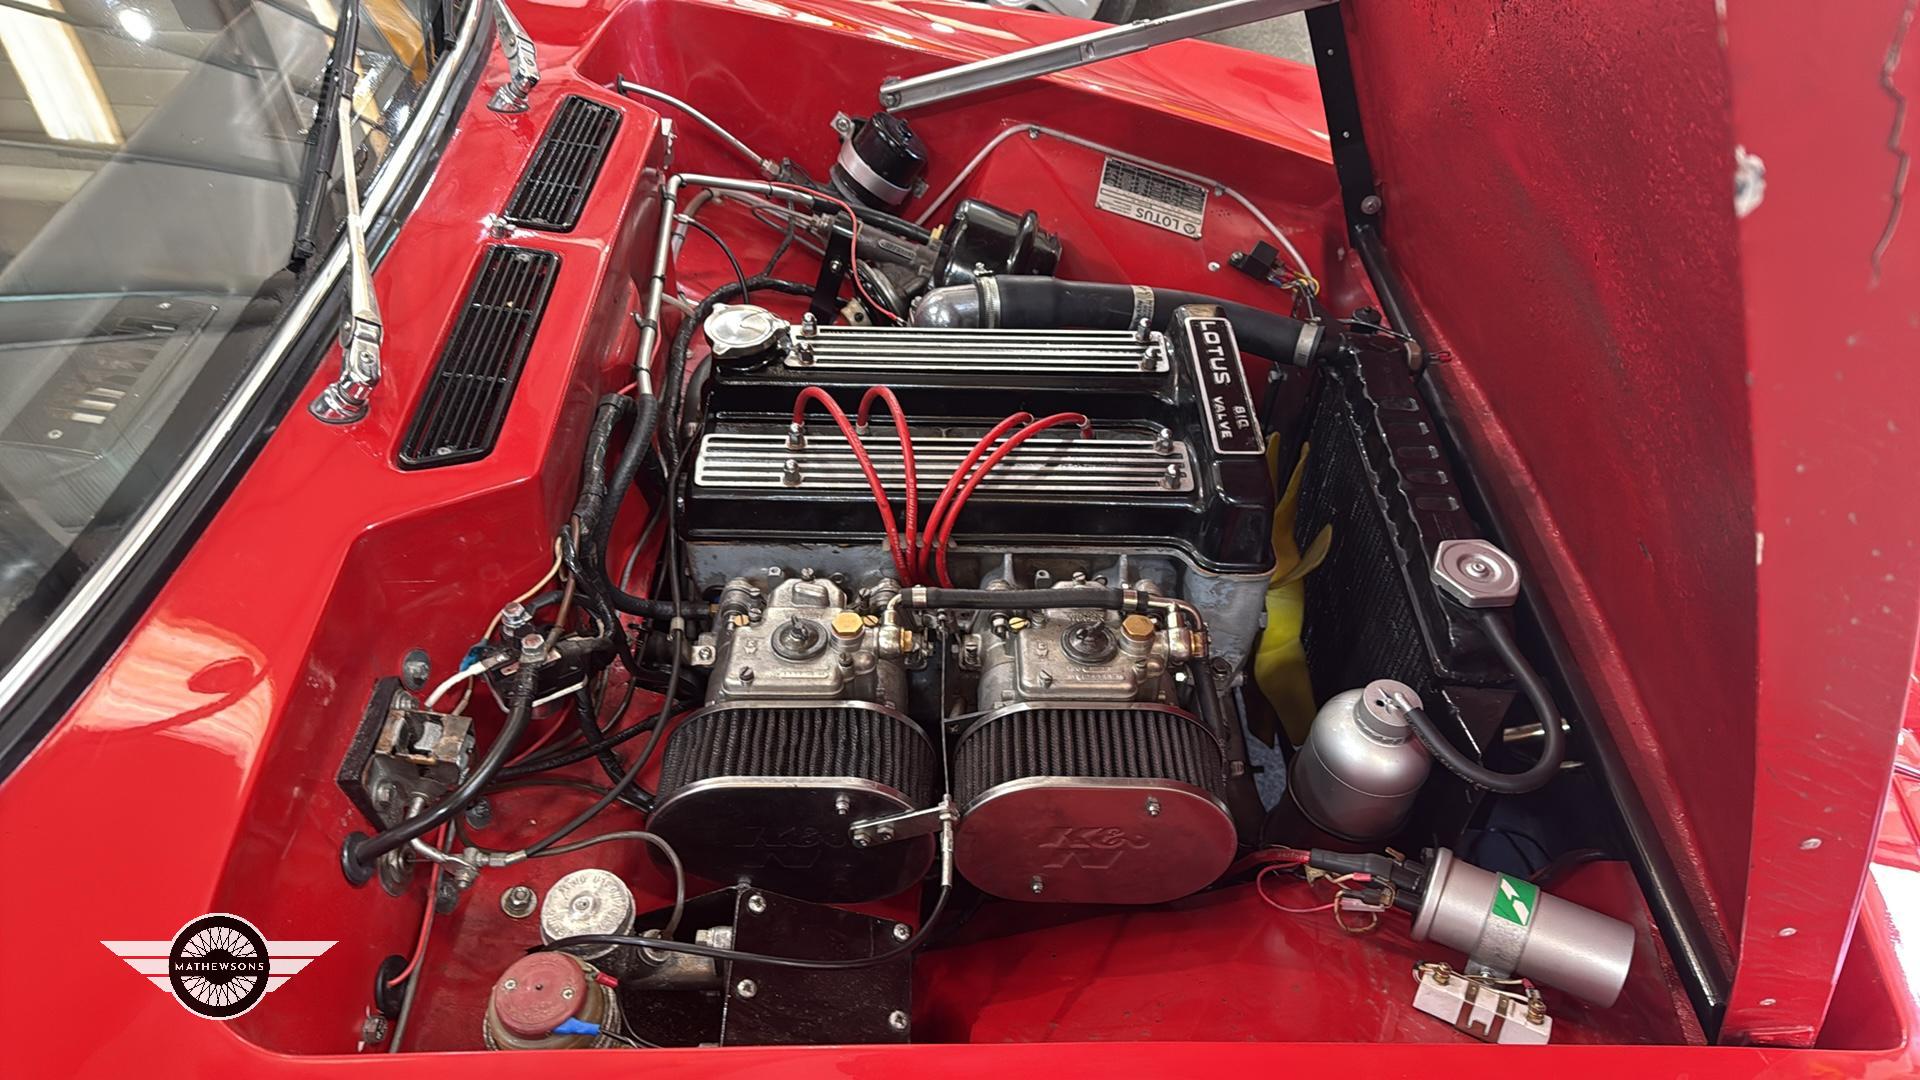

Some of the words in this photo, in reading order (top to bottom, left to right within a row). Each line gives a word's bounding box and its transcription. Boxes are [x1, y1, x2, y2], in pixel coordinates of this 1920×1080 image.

[1136, 208, 1179, 230] LOTUS
[1200, 321, 1231, 385] LOTUS
[1212, 396, 1233, 439] VALVE
[1233, 405, 1250, 430] BIG
